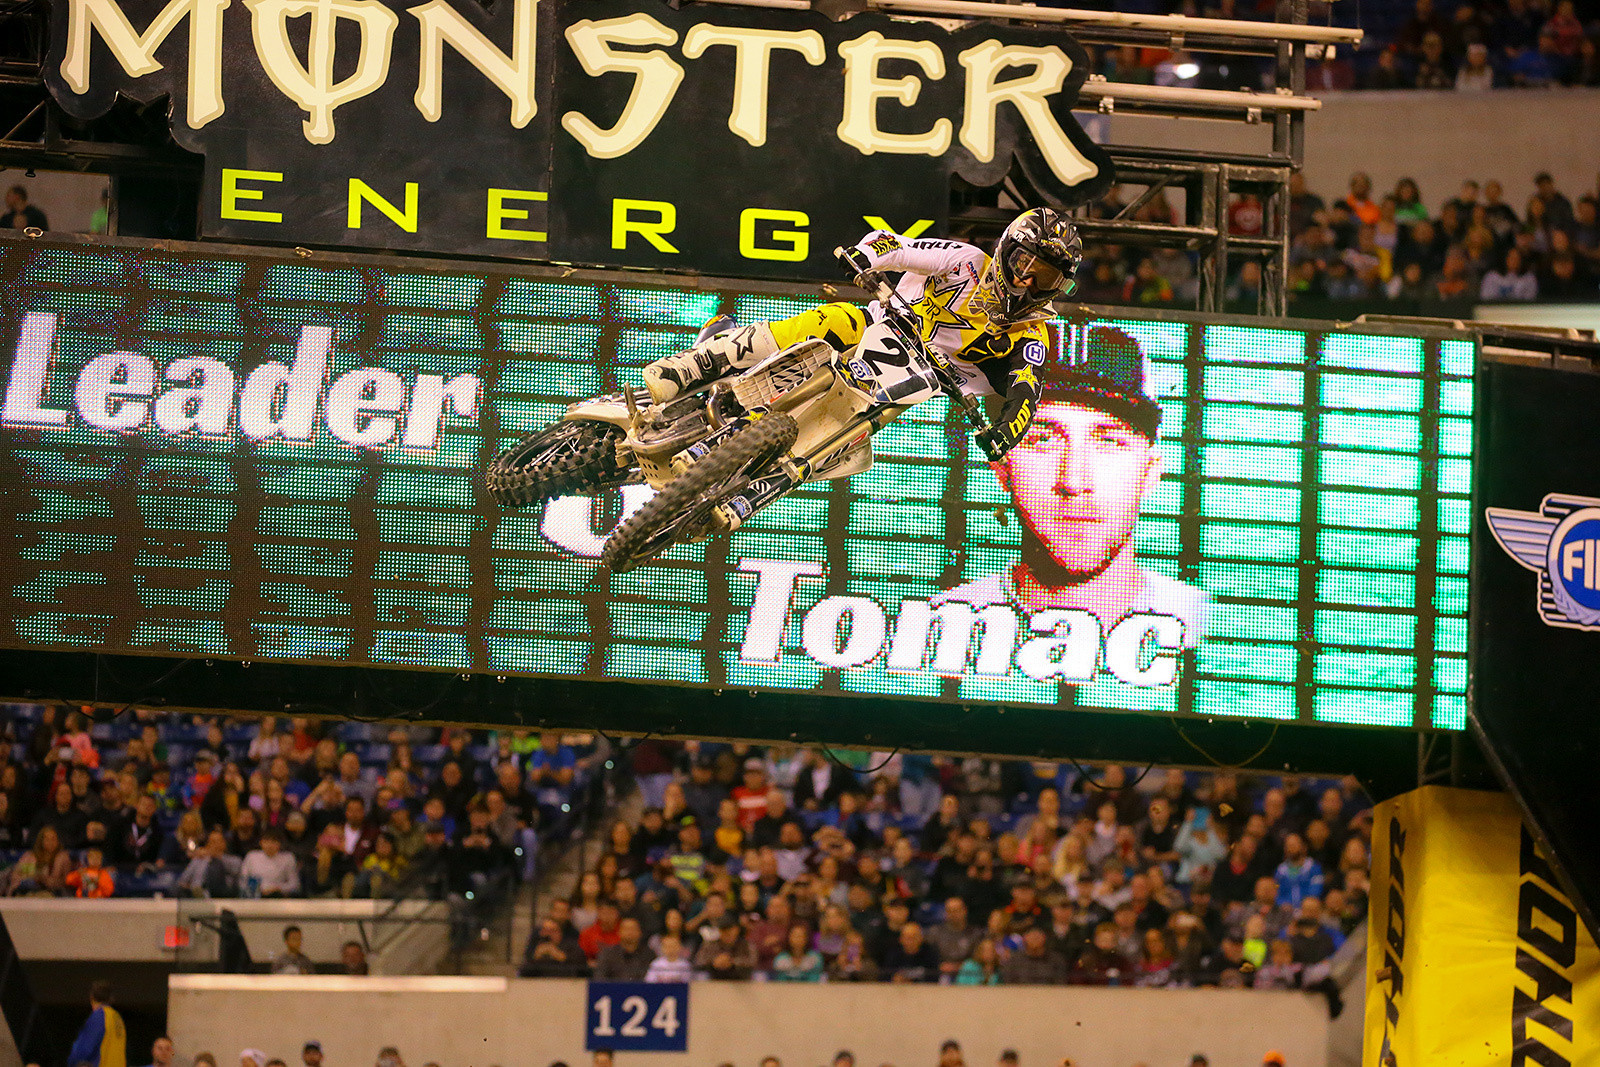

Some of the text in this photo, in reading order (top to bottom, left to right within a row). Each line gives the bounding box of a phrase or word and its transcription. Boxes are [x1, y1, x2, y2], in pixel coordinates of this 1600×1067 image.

[59, 0, 1100, 187] MONSTER
[1, 311, 484, 448] Leader
[861, 337, 929, 402] 21
[1563, 538, 1600, 590] FI
[737, 557, 1186, 687] Tomac
[593, 995, 680, 1037] 124
